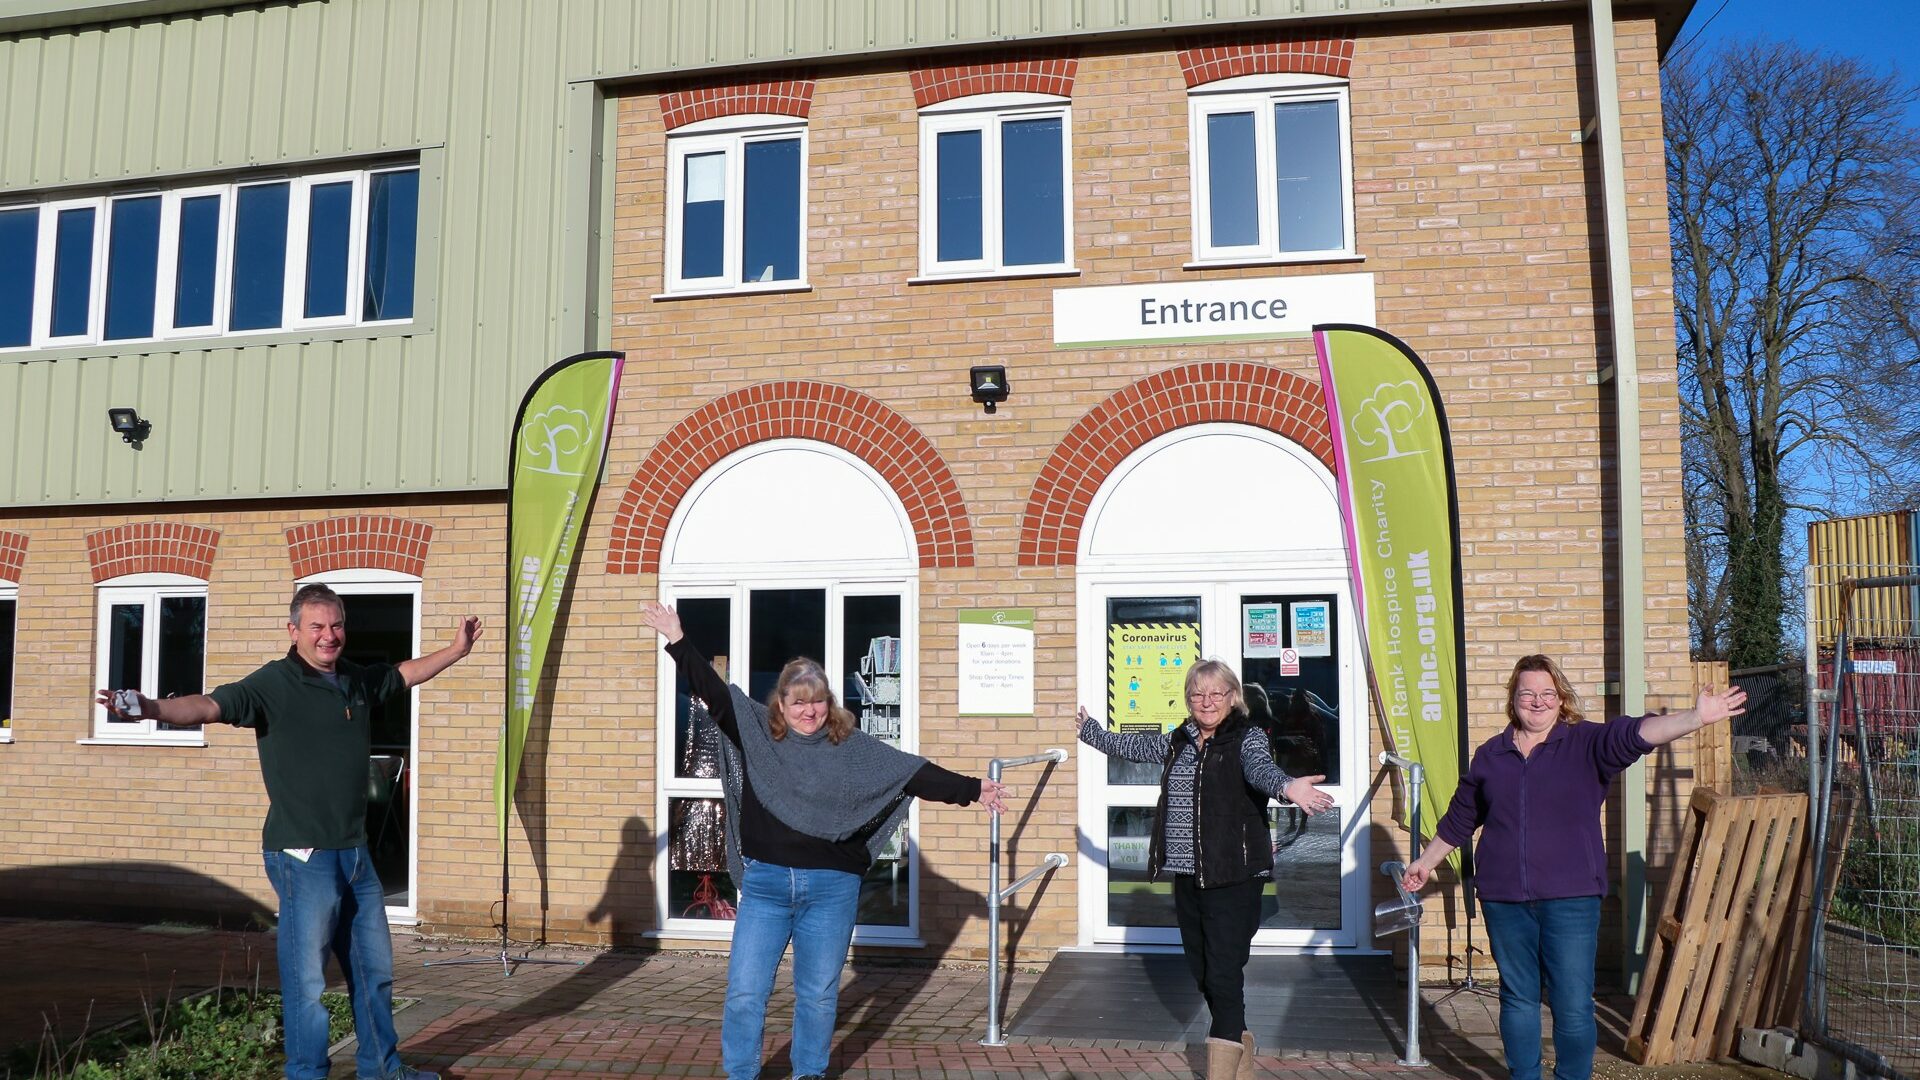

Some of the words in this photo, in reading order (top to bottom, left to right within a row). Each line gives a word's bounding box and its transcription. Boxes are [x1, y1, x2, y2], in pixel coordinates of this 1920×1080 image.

[1141, 297, 1288, 325] Entrance
[1370, 479, 1393, 558] Charity
[551, 564, 570, 611] Rank
[1382, 567, 1403, 655] Hospice
[1122, 632, 1187, 643] Coronavirus
[1407, 549, 1442, 722] arhc.org.uk
[1389, 663, 1409, 717] Rank
[1113, 842, 1145, 850] THANK
[1120, 855, 1138, 863] YOU
